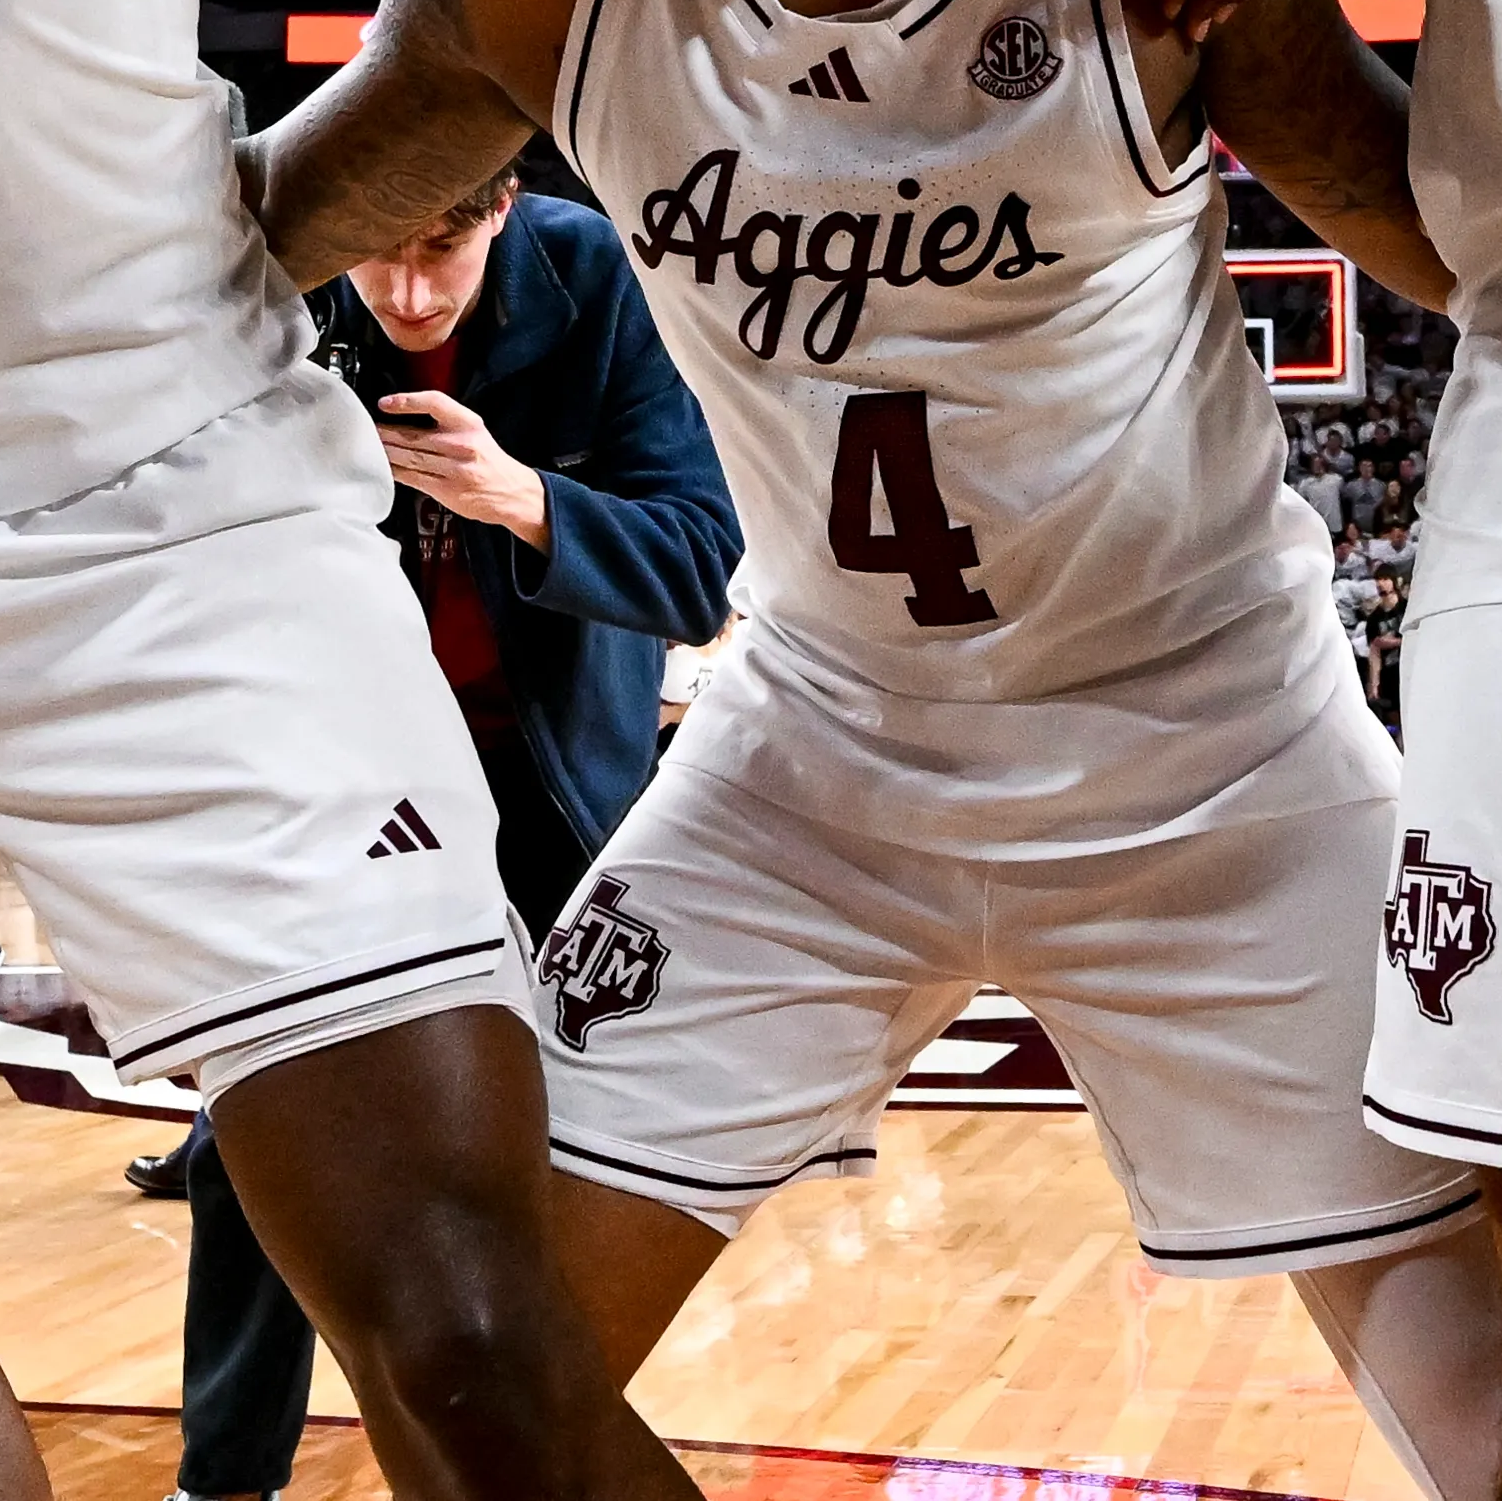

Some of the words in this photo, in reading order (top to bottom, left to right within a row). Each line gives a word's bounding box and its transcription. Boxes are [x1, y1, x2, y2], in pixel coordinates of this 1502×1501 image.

[979, 69, 1049, 97] GRADUATE
[986, 22, 1042, 77] SEC
[631, 149, 1065, 365] Aggies
[826, 389, 999, 628] 4
[551, 902, 655, 1004] ATM
[1390, 864, 1477, 972] ATM
